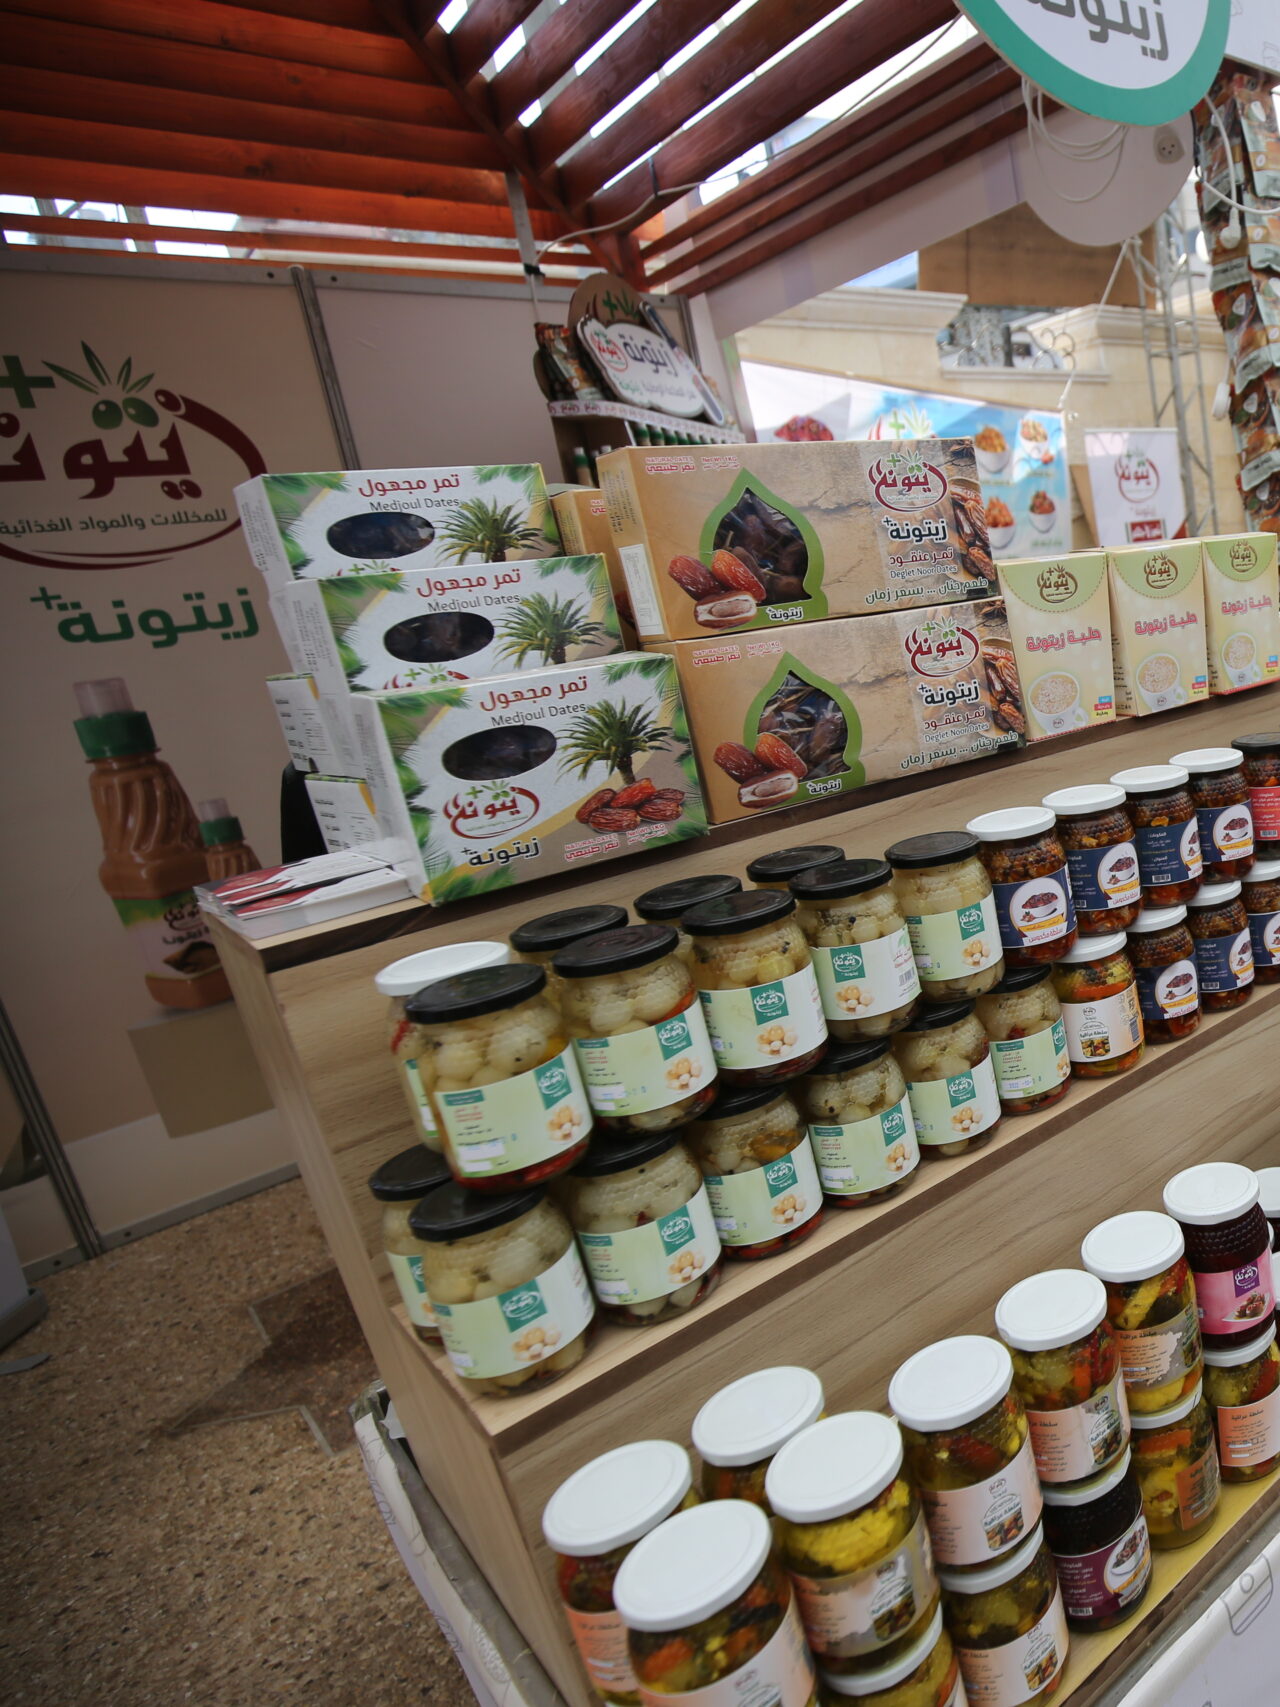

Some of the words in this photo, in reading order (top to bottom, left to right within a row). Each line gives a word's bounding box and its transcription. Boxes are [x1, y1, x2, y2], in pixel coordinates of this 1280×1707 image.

[358, 478, 427, 499] مجهول
[433, 473, 461, 493] تمر
[369, 499, 424, 513] Medjoul
[424, 497, 460, 509] Dates
[0, 517, 73, 536] الغذائية
[78, 513, 147, 533] والمواد
[150, 508, 229, 527] للمخللات
[931, 547, 954, 561] تمر
[493, 569, 521, 590] تمر
[890, 568, 915, 580] Deglet
[916, 566, 935, 576] Noor
[936, 564, 957, 574] Dates
[416, 574, 488, 599] مجهول
[894, 586, 925, 601] بسعر
[428, 597, 483, 614] Medjoul
[484, 593, 521, 608] Dates
[865, 588, 892, 605] زمان
[558, 675, 589, 700] تمر
[480, 684, 554, 713] مجهول
[490, 707, 546, 728] Medjoul
[547, 703, 588, 719] Dates
[964, 706, 986, 723] تمر
[924, 731, 950, 744] Deglet
[950, 725, 968, 737] Noor
[968, 722, 989, 733] Dates
[901, 751, 925, 770] زمان
[926, 747, 957, 764] بسعر
